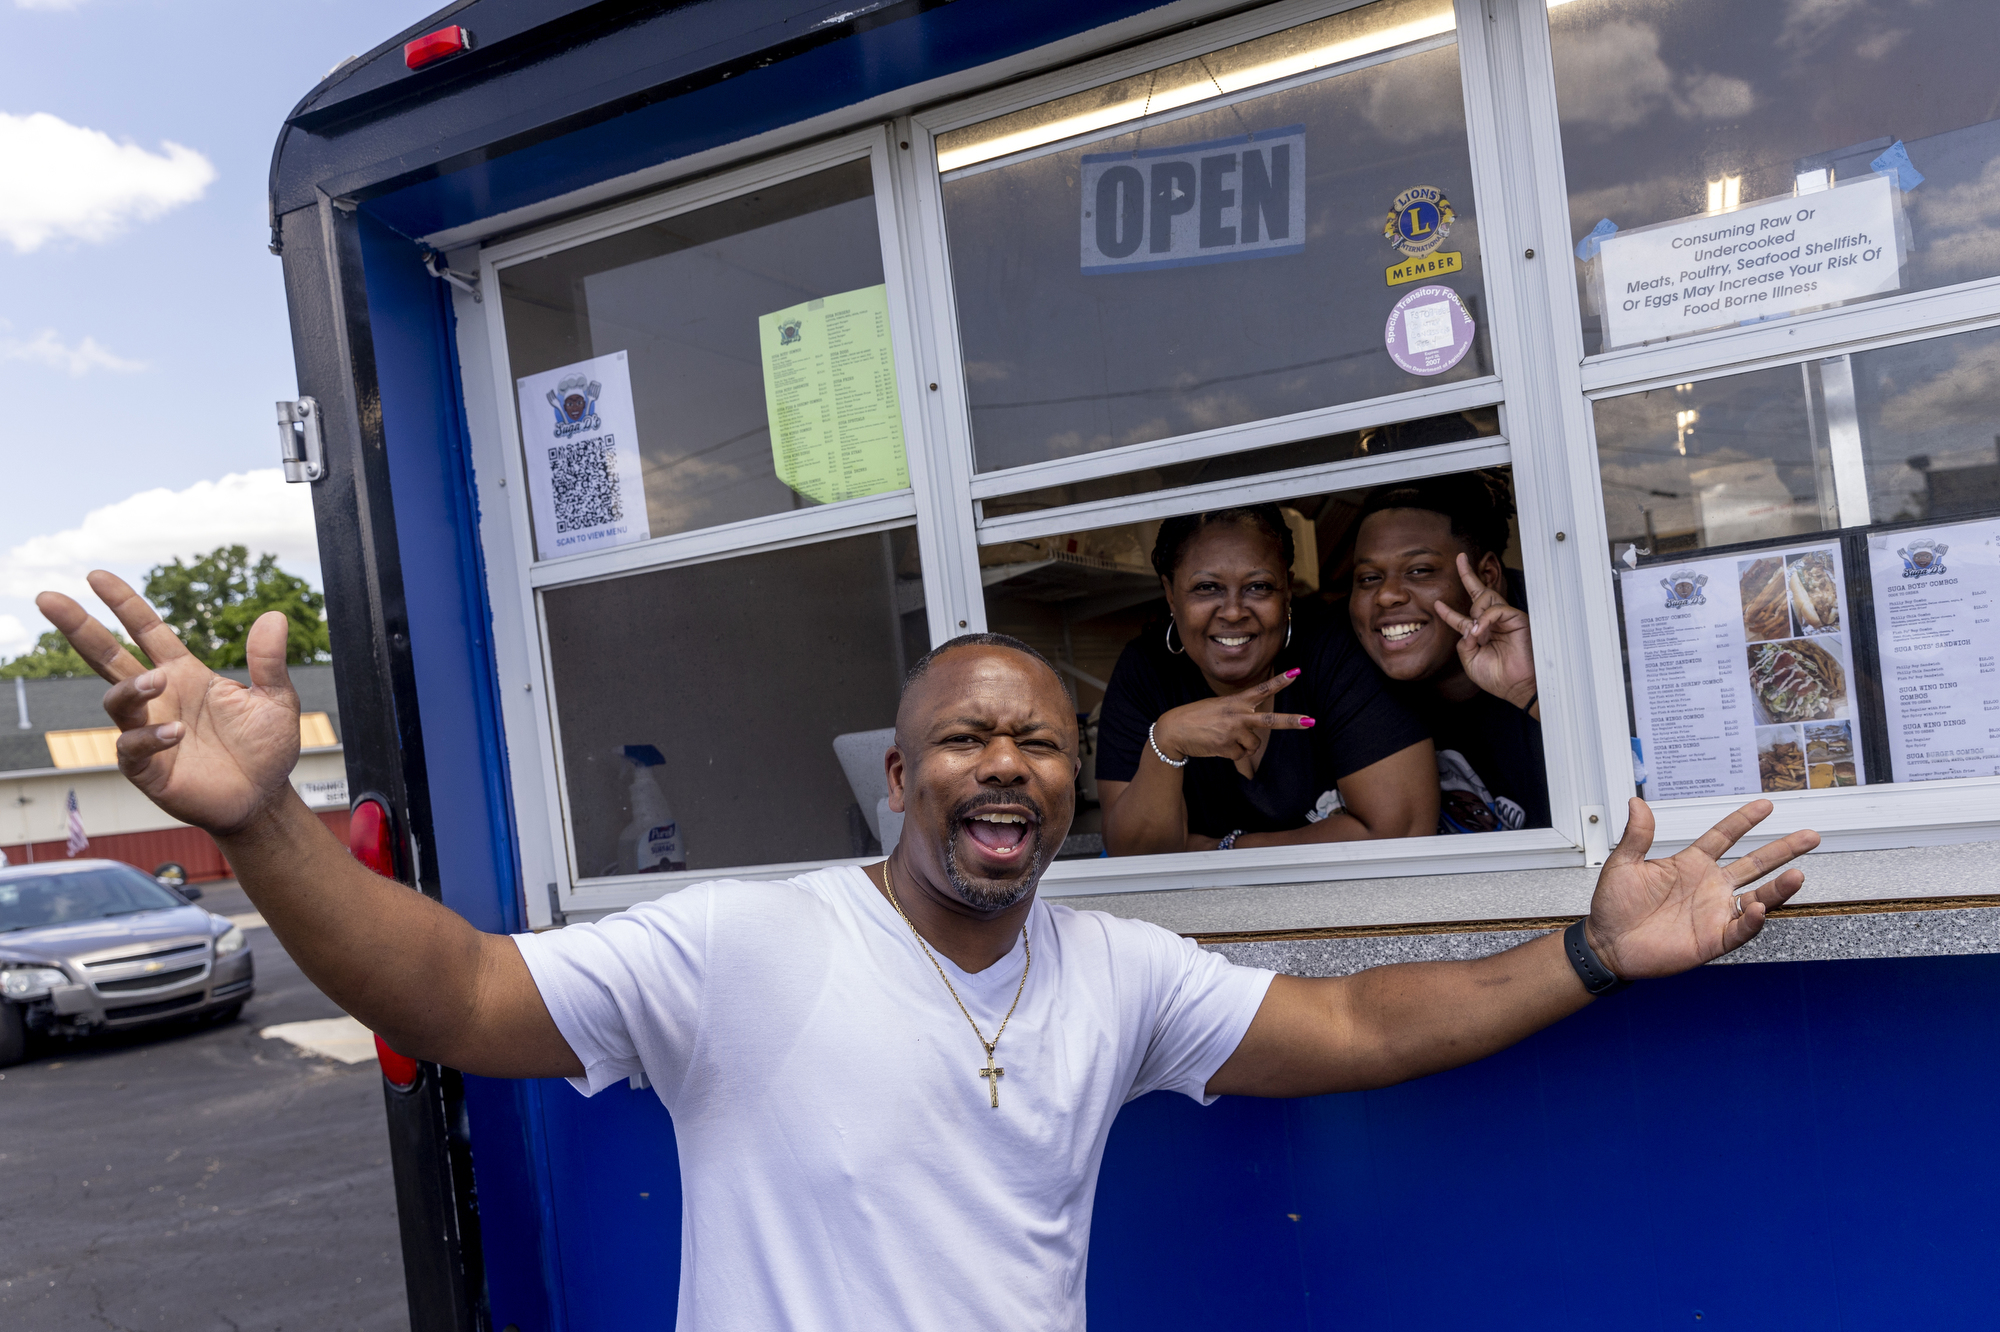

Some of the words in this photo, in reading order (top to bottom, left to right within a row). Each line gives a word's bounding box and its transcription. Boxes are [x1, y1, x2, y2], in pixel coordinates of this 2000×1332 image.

[1096, 144, 1290, 259] OPEN
[1397, 188, 1437, 206] LIONS
[1408, 207, 1431, 236] L
[1671, 223, 1755, 250] Consuming
[1760, 213, 1792, 231] Raw
[1796, 207, 1816, 222] Or
[1400, 235, 1443, 252] NTERNATIONA
[1694, 230, 1796, 263] Undercooked
[1393, 257, 1454, 279] MEMBER
[1626, 275, 1675, 294] Meats,
[1679, 263, 1732, 286] Poultry,
[1736, 247, 1800, 272] Seafood
[1804, 232, 1873, 257] Shellfish,
[1622, 298, 1642, 312] Or
[1644, 290, 1679, 310] Eggs
[1683, 282, 1715, 302] May
[1719, 270, 1785, 293] Increase
[1788, 262, 1823, 278] Your
[1827, 253, 1858, 270] Risk
[1862, 246, 1882, 263] Of
[1683, 299, 1720, 317] Food
[1724, 290, 1768, 309] Borne
[1772, 279, 1818, 299] Illness
[1387, 309, 1400, 344] Special
[1396, 288, 1441, 309] Transitory
[1394, 352, 1412, 370] Michigan
[1412, 365, 1442, 373] Department
[1448, 341, 1468, 364] Agriculture
[1425, 358, 1440, 366] 2007
[556, 537, 576, 547] SCAN
[576, 534, 586, 542] TO
[587, 530, 605, 540] VIEW
[606, 526, 628, 537] MENU
[1887, 585, 1906, 593] SUGA
[1907, 582, 1928, 590] BOYS'
[1929, 578, 1958, 587] COMBOS
[1894, 645, 1912, 653] SUGA
[1913, 643, 1934, 651] BOYS'
[1935, 639, 1971, 649] SANDWICH
[1899, 693, 1928, 701] COMBOS
[1943, 719, 1966, 727] DINGS
[1906, 752, 1924, 760] SUGA
[1926, 749, 1954, 758] BURGER
[1956, 748, 1985, 756] COMBOS
